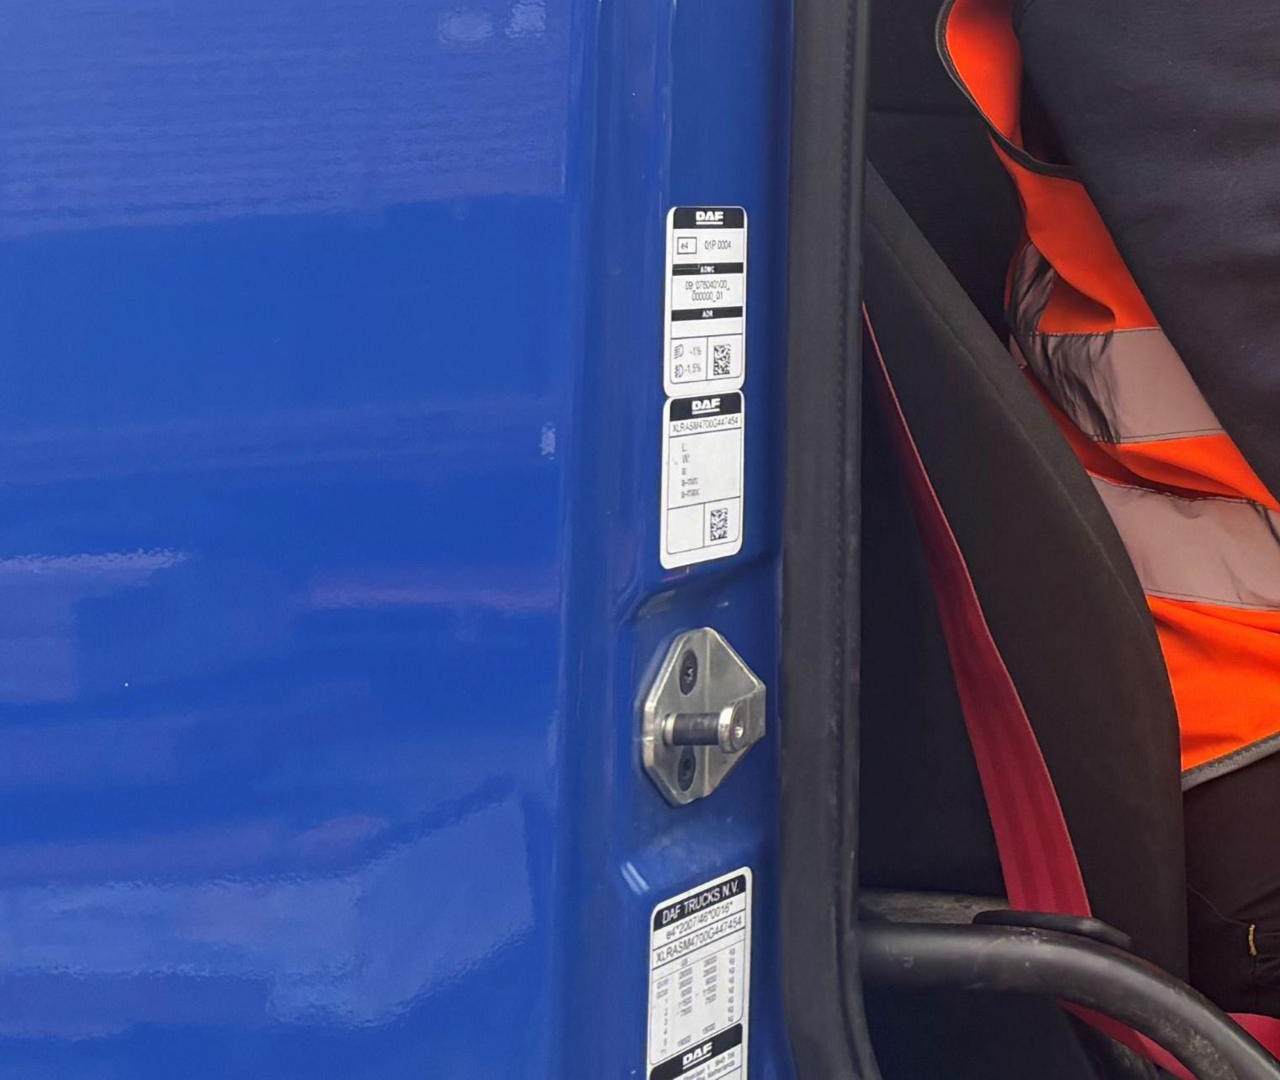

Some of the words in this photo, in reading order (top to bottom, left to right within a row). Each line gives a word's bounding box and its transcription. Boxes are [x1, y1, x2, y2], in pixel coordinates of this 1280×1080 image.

[695, 210, 724, 222] DAF
[691, 398, 721, 413] DAF
[661, 907, 681, 925] DAF
[683, 887, 721, 917] TRUCKS
[722, 879, 740, 898] N.V.
[682, 1041, 713, 1068] DAF
